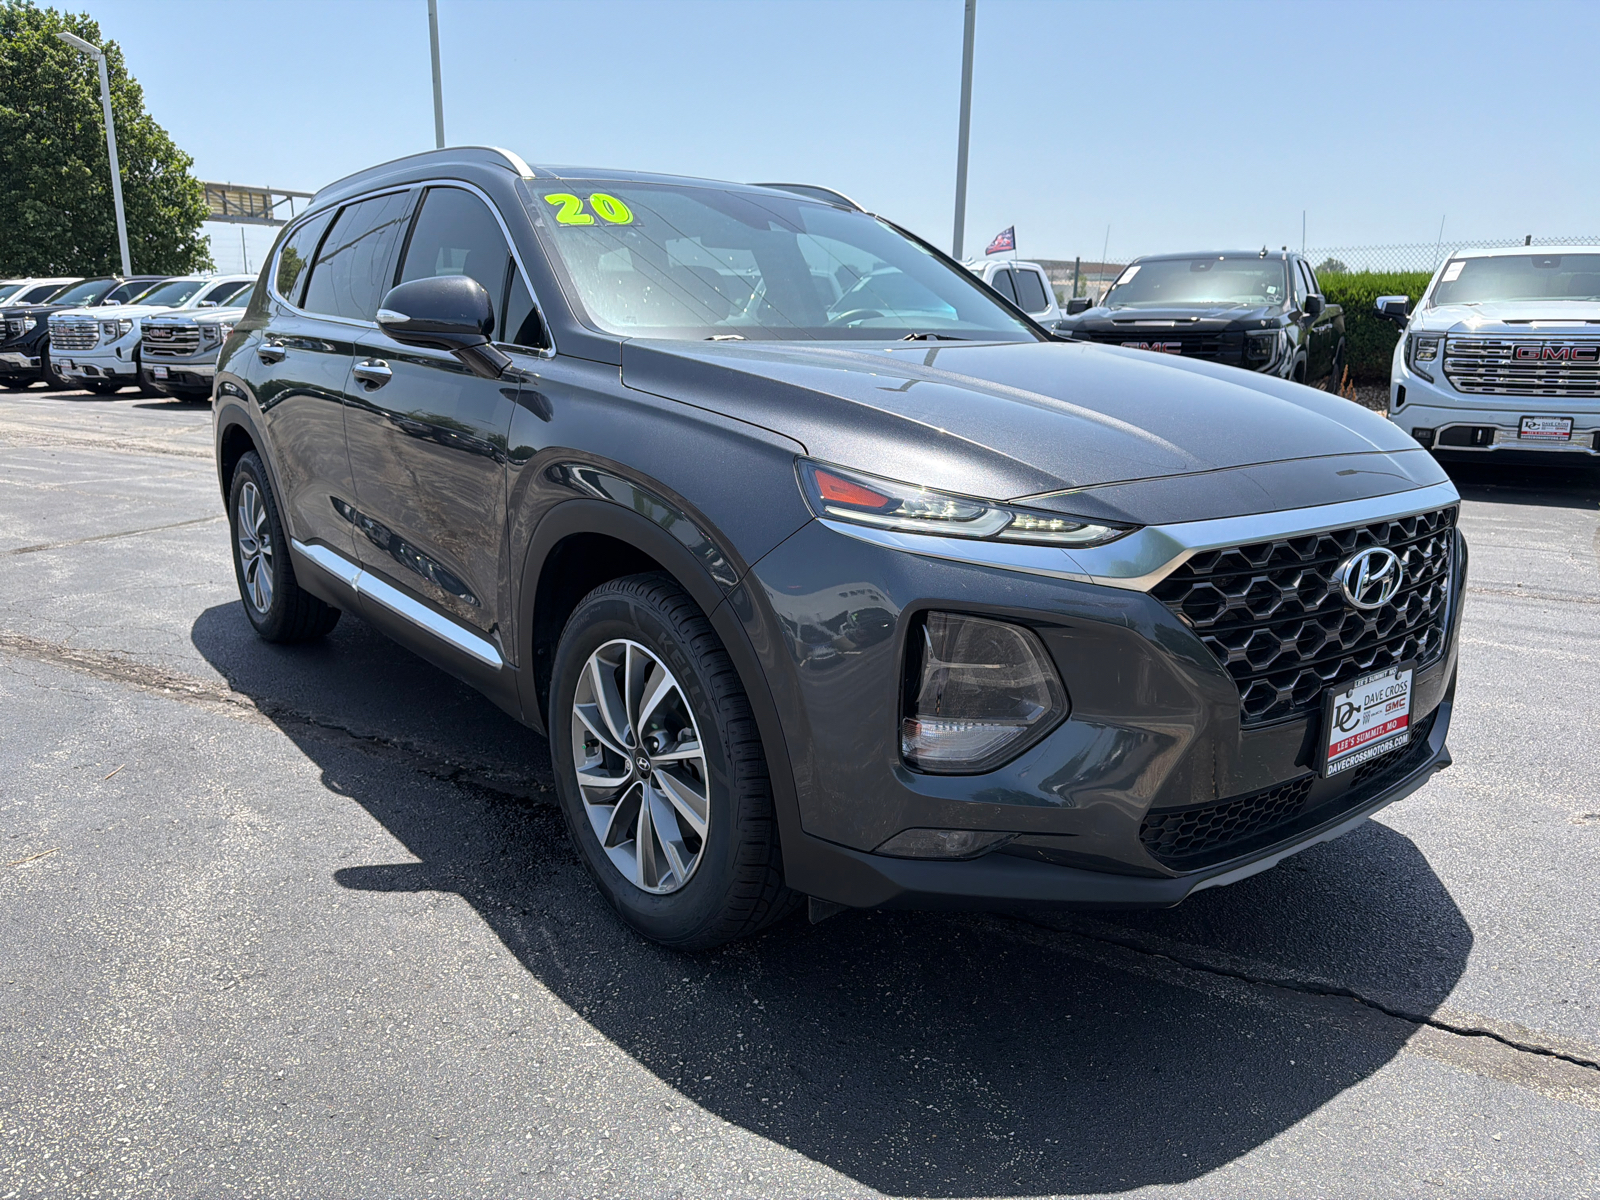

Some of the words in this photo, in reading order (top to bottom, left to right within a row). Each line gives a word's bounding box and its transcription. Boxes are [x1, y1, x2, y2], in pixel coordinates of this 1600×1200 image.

[544, 193, 634, 225] 20
[149, 329, 172, 337] GMC
[1517, 347, 1597, 360] GMC
[657, 631, 712, 720] KELLY
[1364, 689, 1384, 706] DAVE
[1385, 680, 1408, 698] CROSS
[1385, 697, 1406, 712] GMC
[1337, 737, 1355, 752] LEE'S
[1356, 726, 1385, 743] SUMMIT,
[1386, 720, 1398, 732] MO
[1327, 734, 1408, 775] DAVECROSSMOTORS.COM
